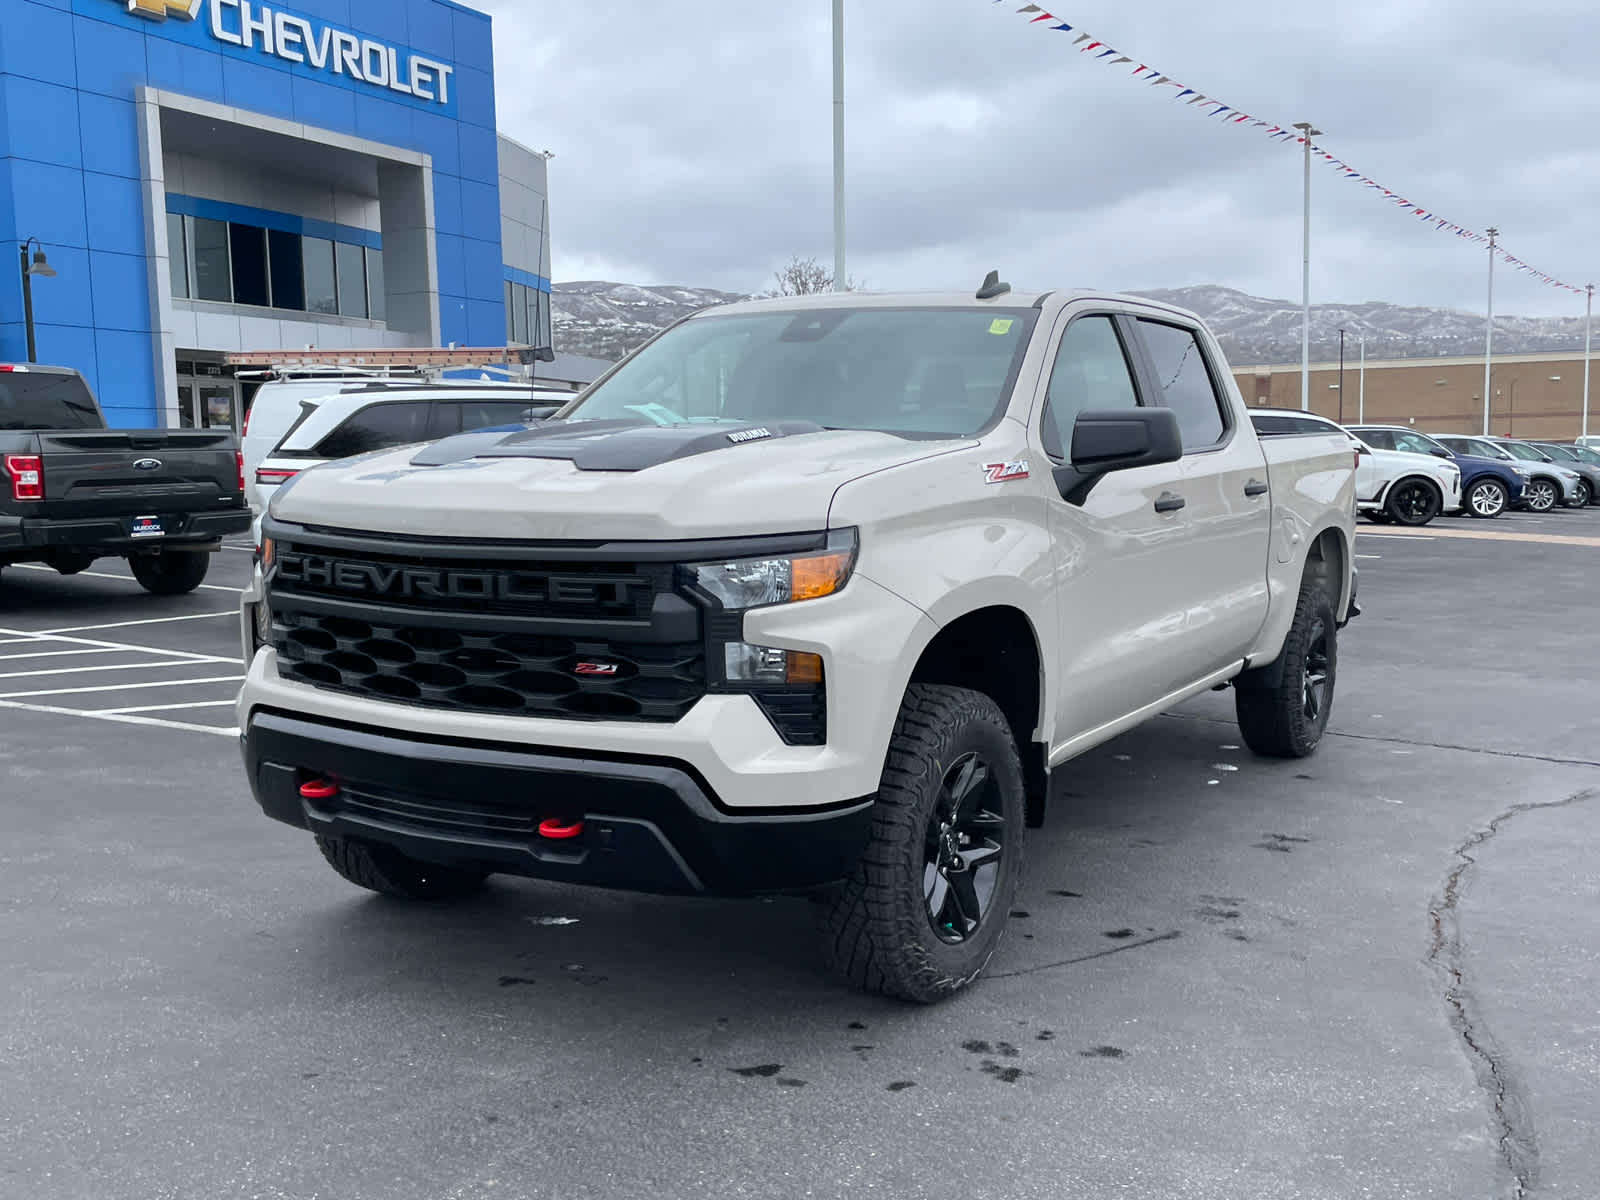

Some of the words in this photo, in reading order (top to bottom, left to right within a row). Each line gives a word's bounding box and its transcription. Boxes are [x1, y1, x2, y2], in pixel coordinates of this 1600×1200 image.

[210, 0, 453, 104] CHEVROLET
[982, 460, 1030, 484] Z71
[276, 555, 650, 602] CHEVROLET
[576, 662, 618, 675] Z71
